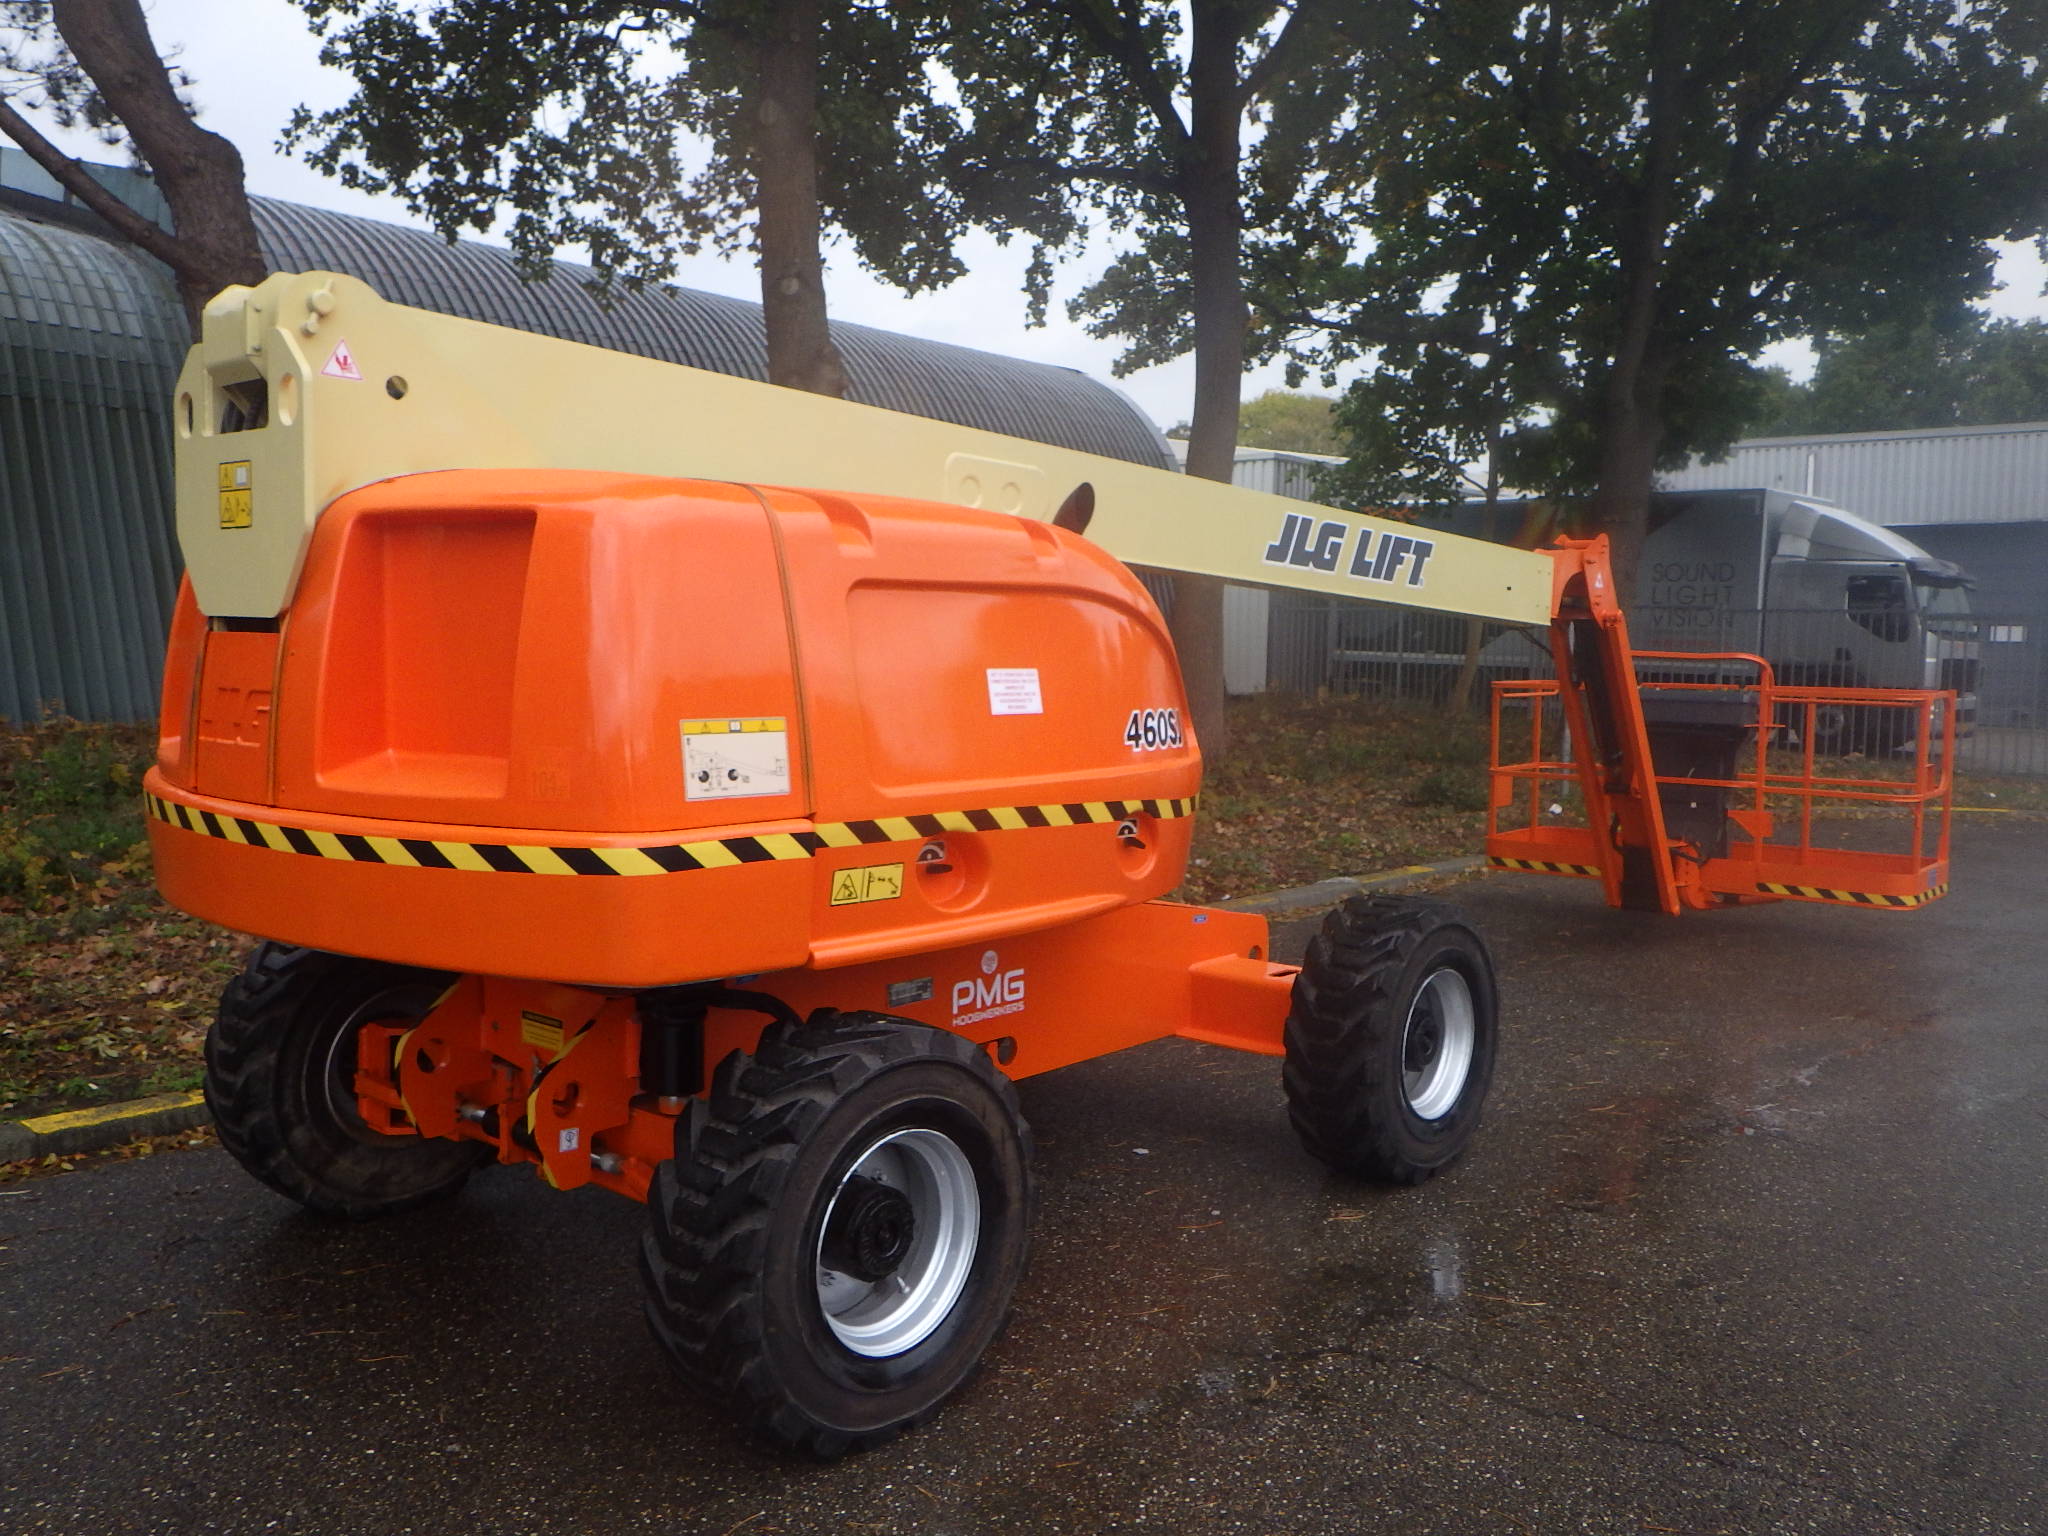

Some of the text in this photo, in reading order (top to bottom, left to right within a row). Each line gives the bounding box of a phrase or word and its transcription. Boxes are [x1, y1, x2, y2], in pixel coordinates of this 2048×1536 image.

[1264, 512, 1434, 586] JLG LIFT
[1652, 562, 1735, 582] SOUND
[1652, 586, 1735, 605] LIGHT
[952, 968, 1025, 1016] PMG
